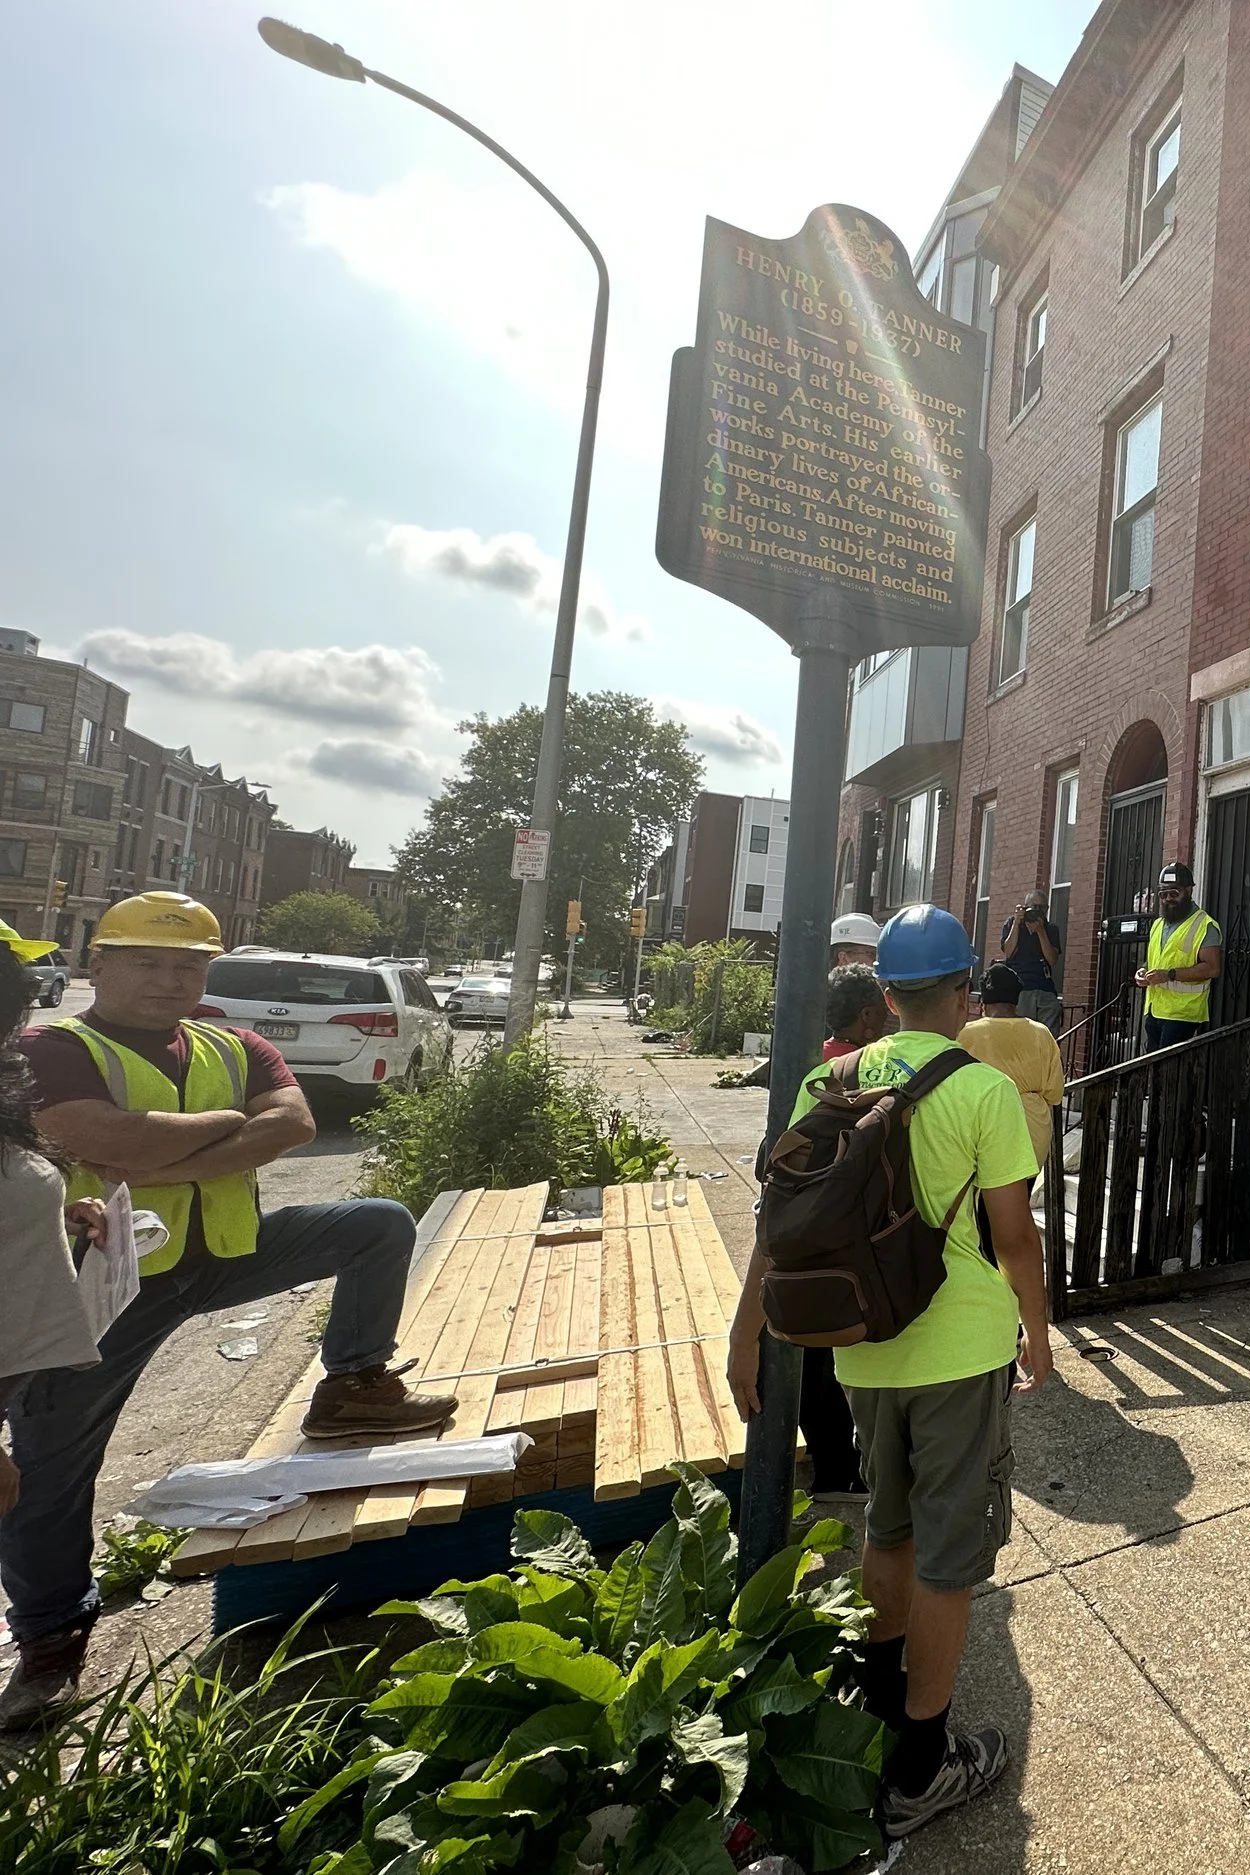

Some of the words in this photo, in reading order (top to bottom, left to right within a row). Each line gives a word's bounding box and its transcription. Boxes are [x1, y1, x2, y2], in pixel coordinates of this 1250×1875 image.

[736, 246, 825, 298] HENRY
[838, 290, 858, 313] O.
[871, 302, 963, 355] TANNER
[715, 340, 802, 381] studied
[809, 374, 830, 391] at
[836, 379, 870, 405] the
[876, 391, 965, 437] Pennsyl-
[717, 310, 780, 350] While
[786, 335, 844, 378] living
[899, 379, 966, 418] Tanner
[708, 407, 775, 440] works
[780, 431, 888, 478] portrayed
[893, 465, 924, 488] the
[929, 481, 960, 498] or-
[711, 380, 768, 414] Fine
[777, 404, 838, 439] Arts.
[843, 425, 879, 452] His
[890, 446, 962, 480] earlier
[712, 362, 779, 396] vania
[788, 386, 894, 438] Academy
[902, 429, 928, 446] of
[932, 436, 964, 460] the
[703, 476, 727, 496] to
[800, 501, 877, 539] Tanner
[882, 531, 956, 562] painted
[704, 452, 825, 503] Americans.
[825, 488, 887, 520] After
[889, 510, 957, 546] moving
[707, 428, 785, 470] dinary
[791, 453, 839, 484] lives
[846, 476, 872, 494] of
[871, 480, 959, 519] African-
[699, 525, 743, 549] won
[749, 533, 877, 584] international
[881, 575, 953, 604] acclaim.
[701, 502, 807, 543] religious
[819, 536, 907, 570] subjects
[916, 562, 954, 583] and
[840, 581, 869, 593] MUSEUM
[517, 831, 528, 842] NO
